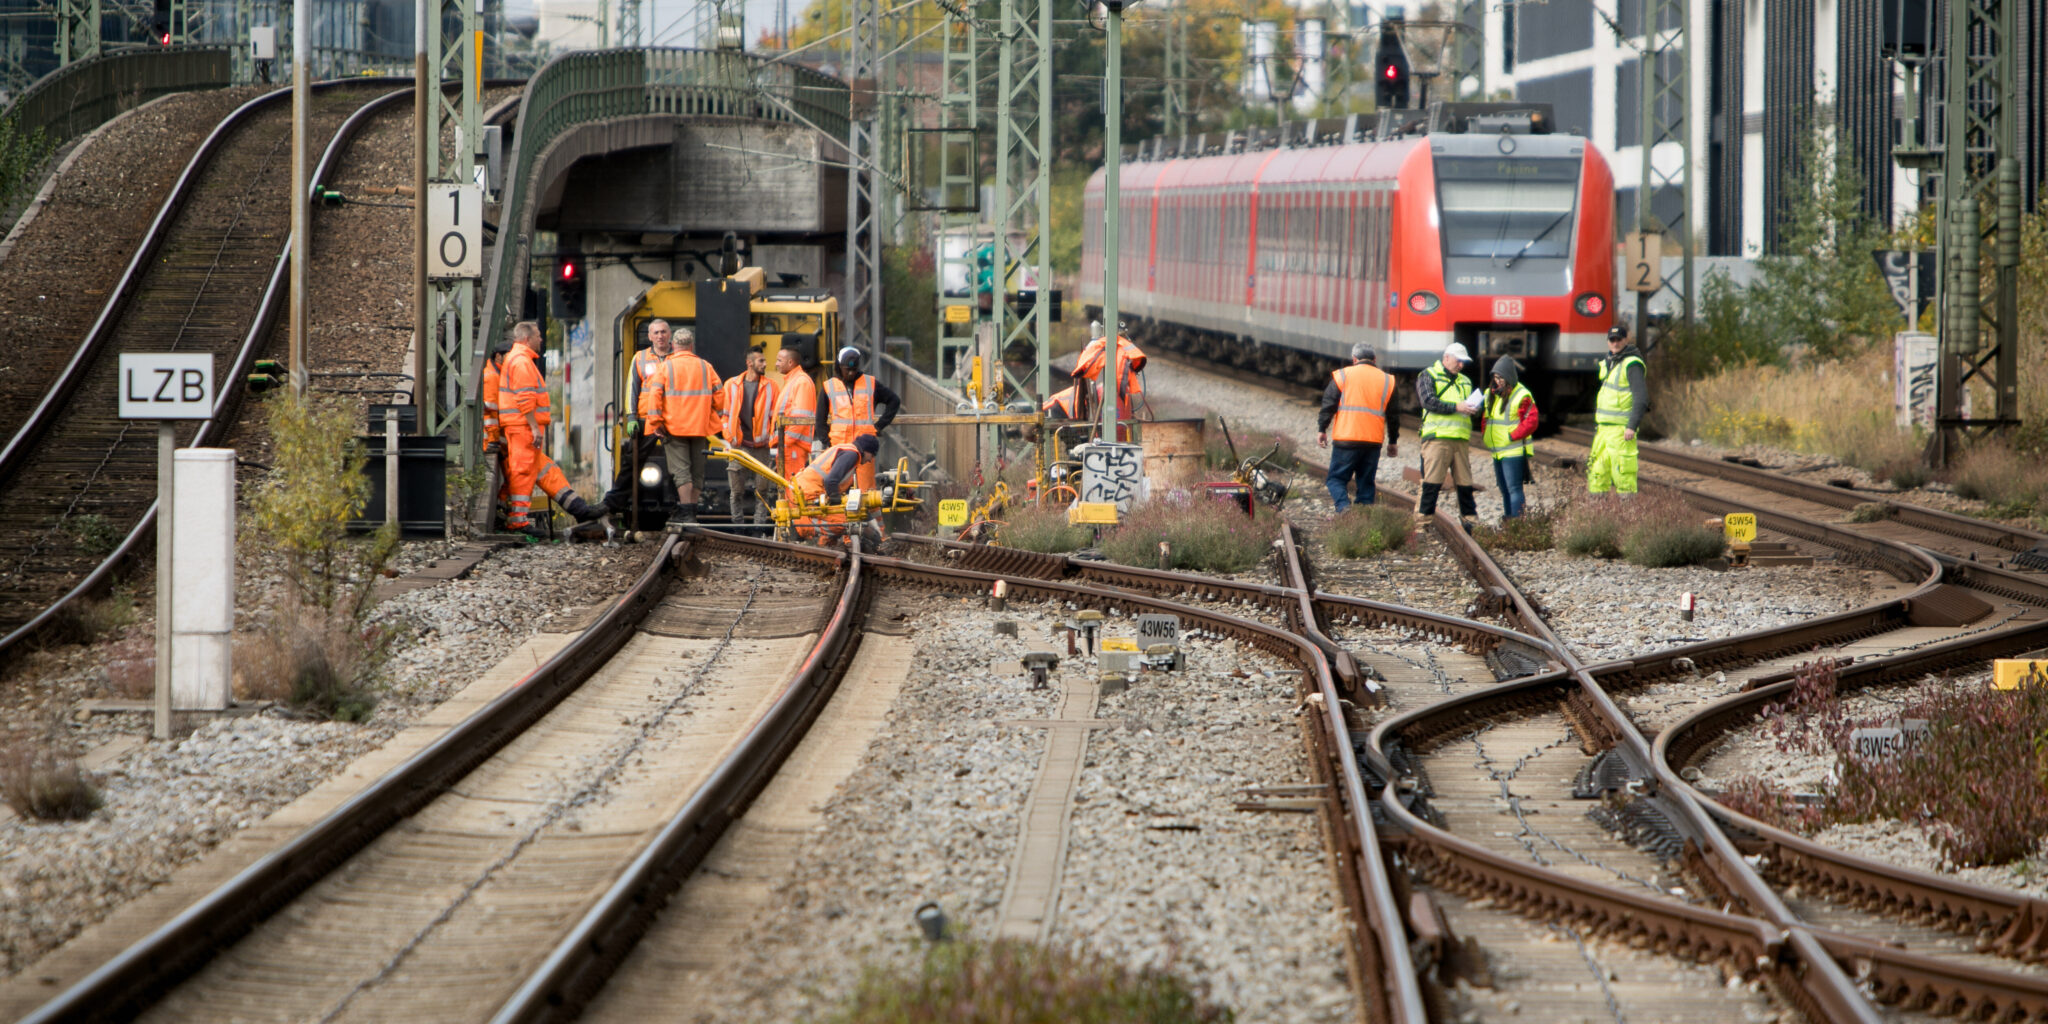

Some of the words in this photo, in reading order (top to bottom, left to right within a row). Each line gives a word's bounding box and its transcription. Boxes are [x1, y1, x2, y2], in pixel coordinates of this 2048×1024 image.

[448, 190, 460, 226] 1
[440, 231, 467, 267] 0
[1639, 237, 1646, 259] 1
[1636, 263, 1650, 286] 2
[1496, 301, 1521, 316] DB
[127, 368, 204, 402] LZB
[941, 503, 965, 511] 43W57
[948, 514, 959, 522] HV
[1728, 516, 1753, 526] 43W54
[1735, 528, 1746, 537] HV
[1141, 620, 1175, 638] 43W56
